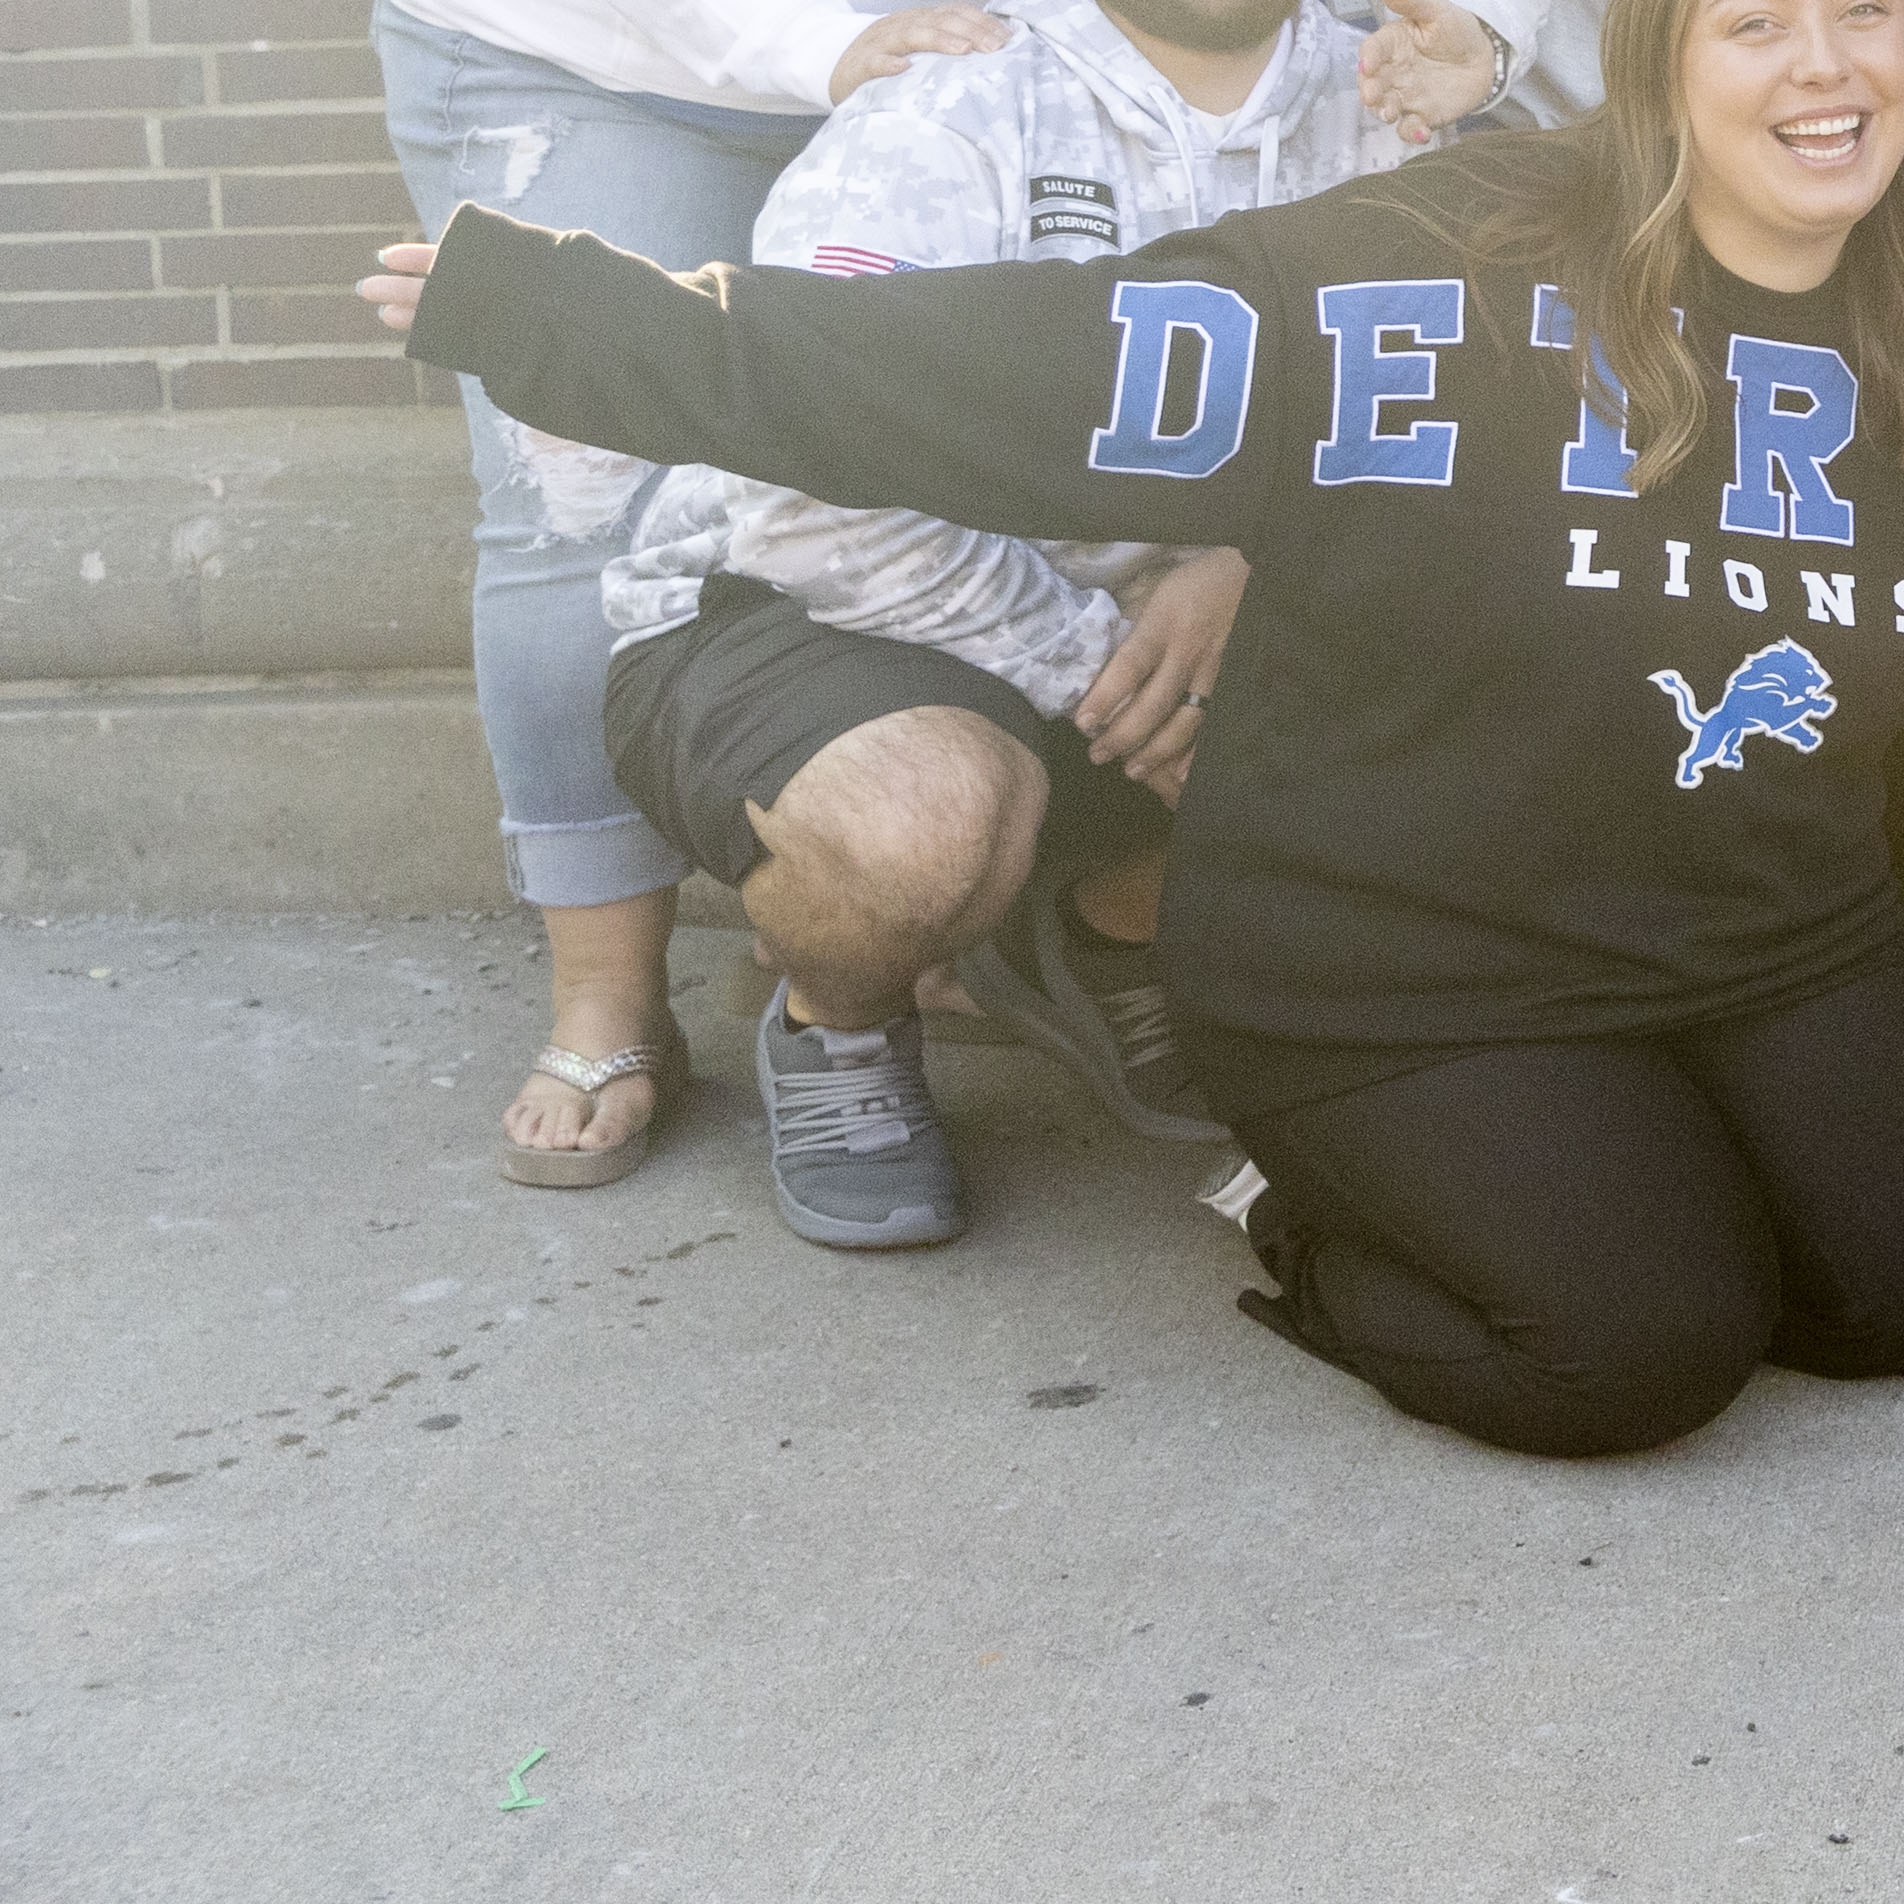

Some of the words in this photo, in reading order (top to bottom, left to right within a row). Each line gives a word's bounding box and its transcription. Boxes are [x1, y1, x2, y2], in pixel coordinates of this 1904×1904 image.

[1042, 181, 1096, 198] SALUTE
[1039, 217, 1054, 230] TO
[1055, 216, 1113, 236] SERVICE
